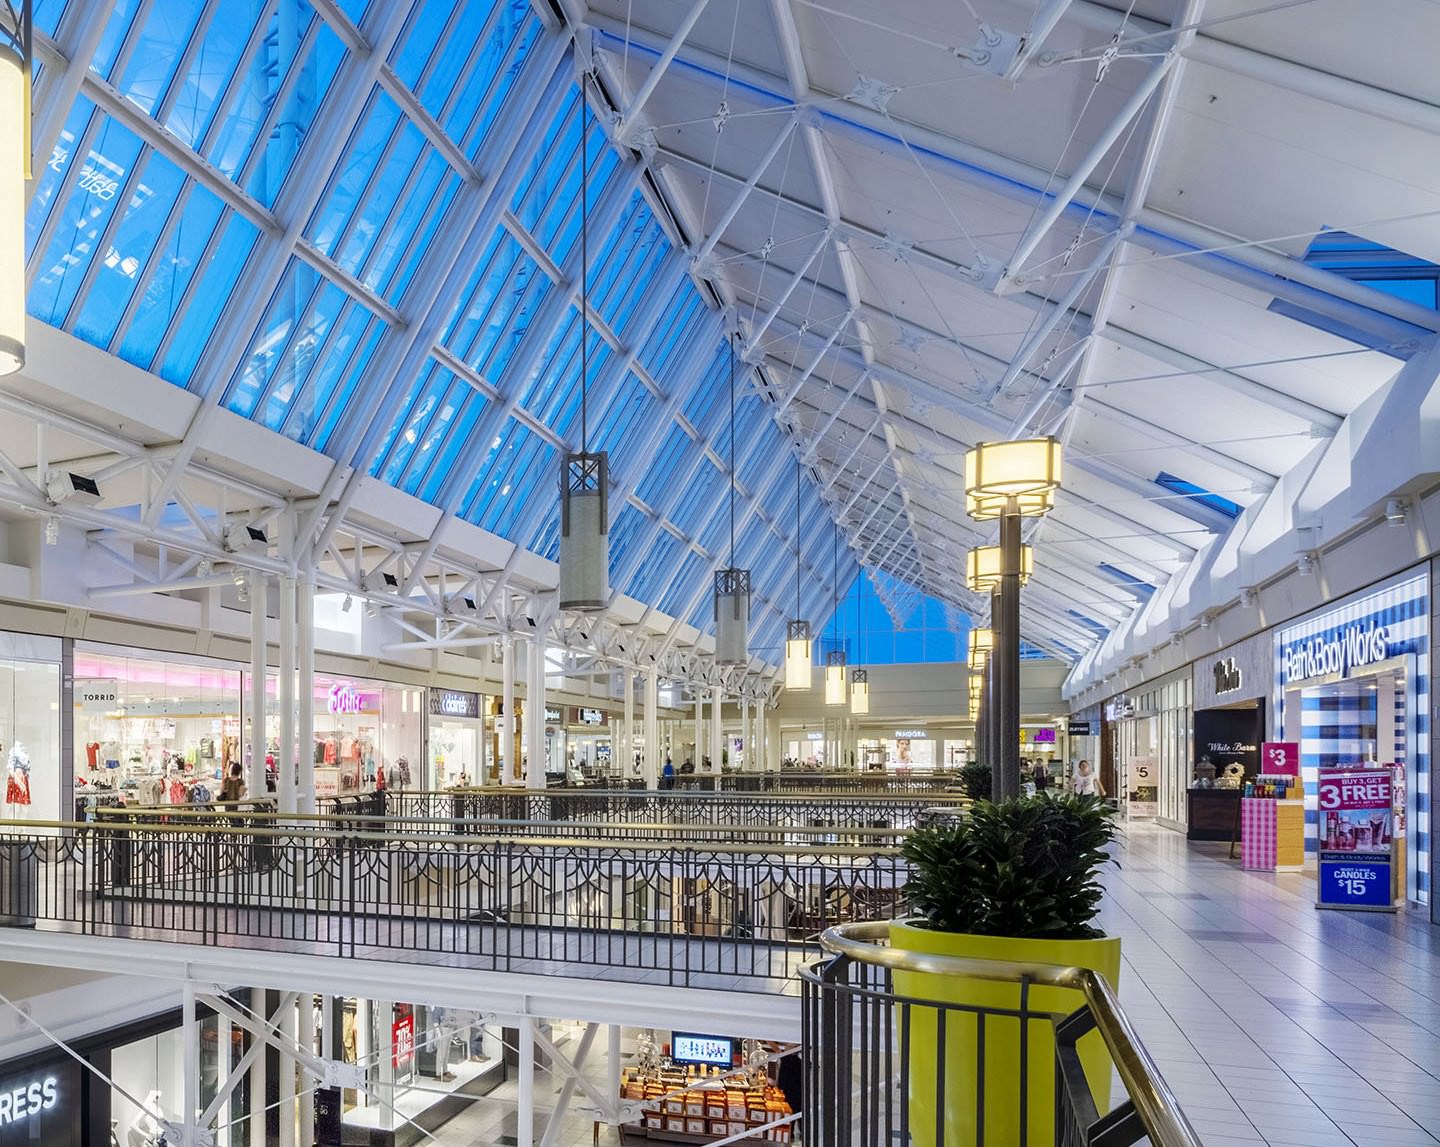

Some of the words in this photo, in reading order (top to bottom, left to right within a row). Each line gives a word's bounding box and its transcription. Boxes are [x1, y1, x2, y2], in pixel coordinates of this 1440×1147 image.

[1346, 620, 1386, 667] Works
[1269, 749, 1287, 766] $3
[1136, 766, 1149, 778] $5
[1320, 784, 1342, 808] 3
[1342, 784, 1390, 800] FREE
[1333, 870, 1377, 880] CANDLES
[1338, 879, 1366, 895] $15
